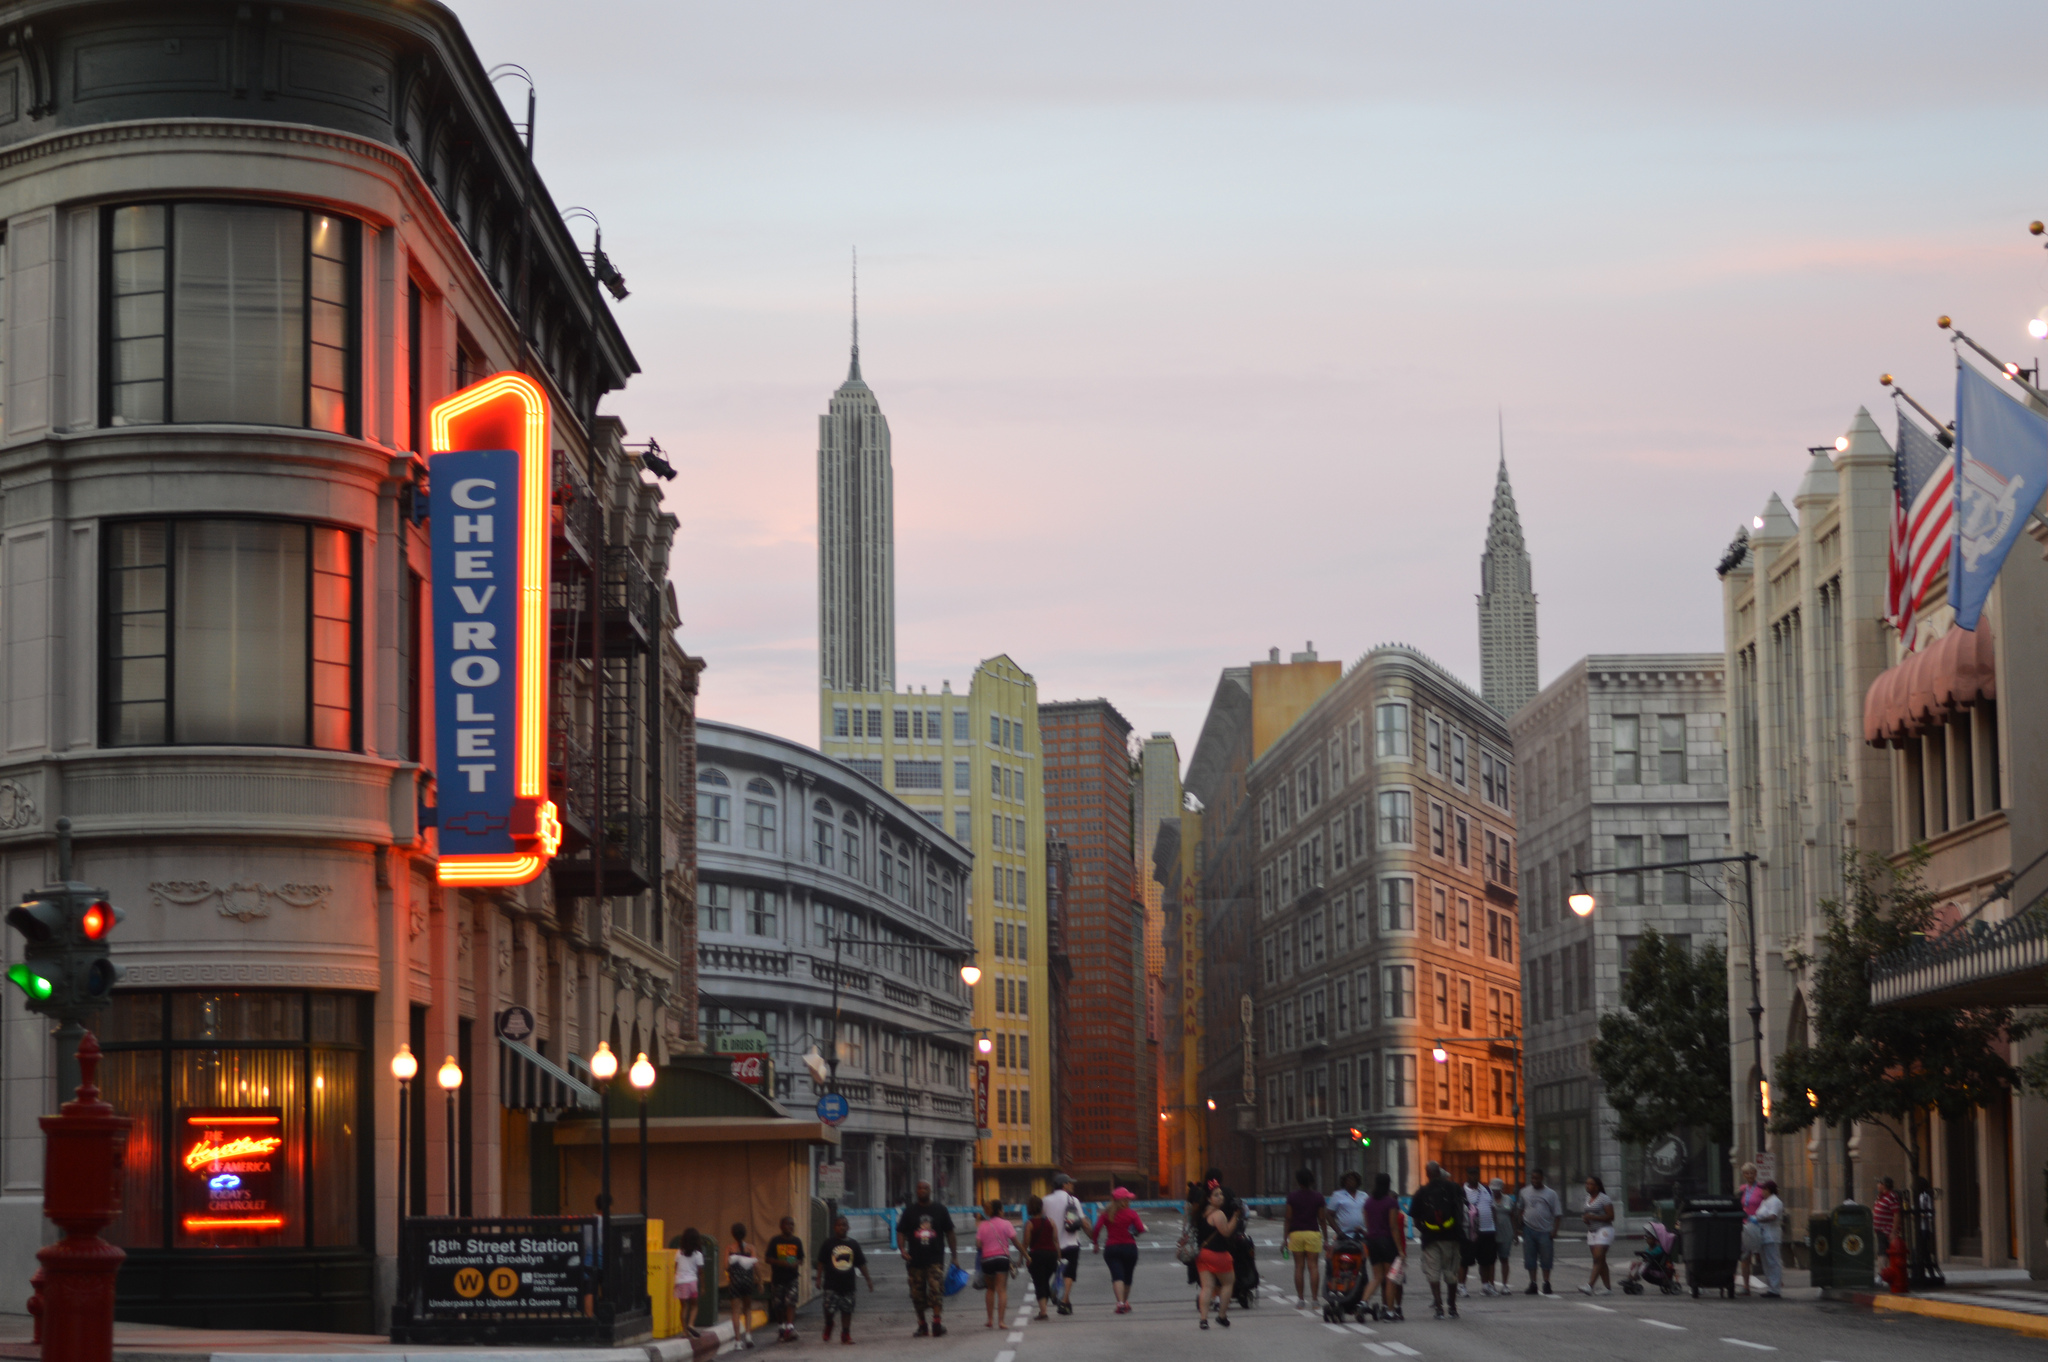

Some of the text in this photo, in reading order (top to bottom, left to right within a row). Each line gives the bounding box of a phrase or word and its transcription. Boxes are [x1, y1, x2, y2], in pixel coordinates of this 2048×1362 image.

[450, 477, 500, 793] CHEVROLET
[1183, 875, 1197, 1037] AMSTERDAM
[978, 1064, 987, 1125] PARK
[203, 1130, 224, 1141] THE
[223, 1162, 271, 1172] AMERICA
[208, 1200, 267, 1211] CHEVROLET
[428, 1238, 579, 1254] 18th Street Station
[428, 1254, 544, 1266] Downtown & Brooklyn
[459, 1274, 512, 1291] W D
[428, 1299, 475, 1309] Underpass
[476, 1299, 485, 1308] to
[486, 1298, 519, 1309] Uptown
[520, 1298, 527, 1307] &
[529, 1298, 561, 1307] Queens
